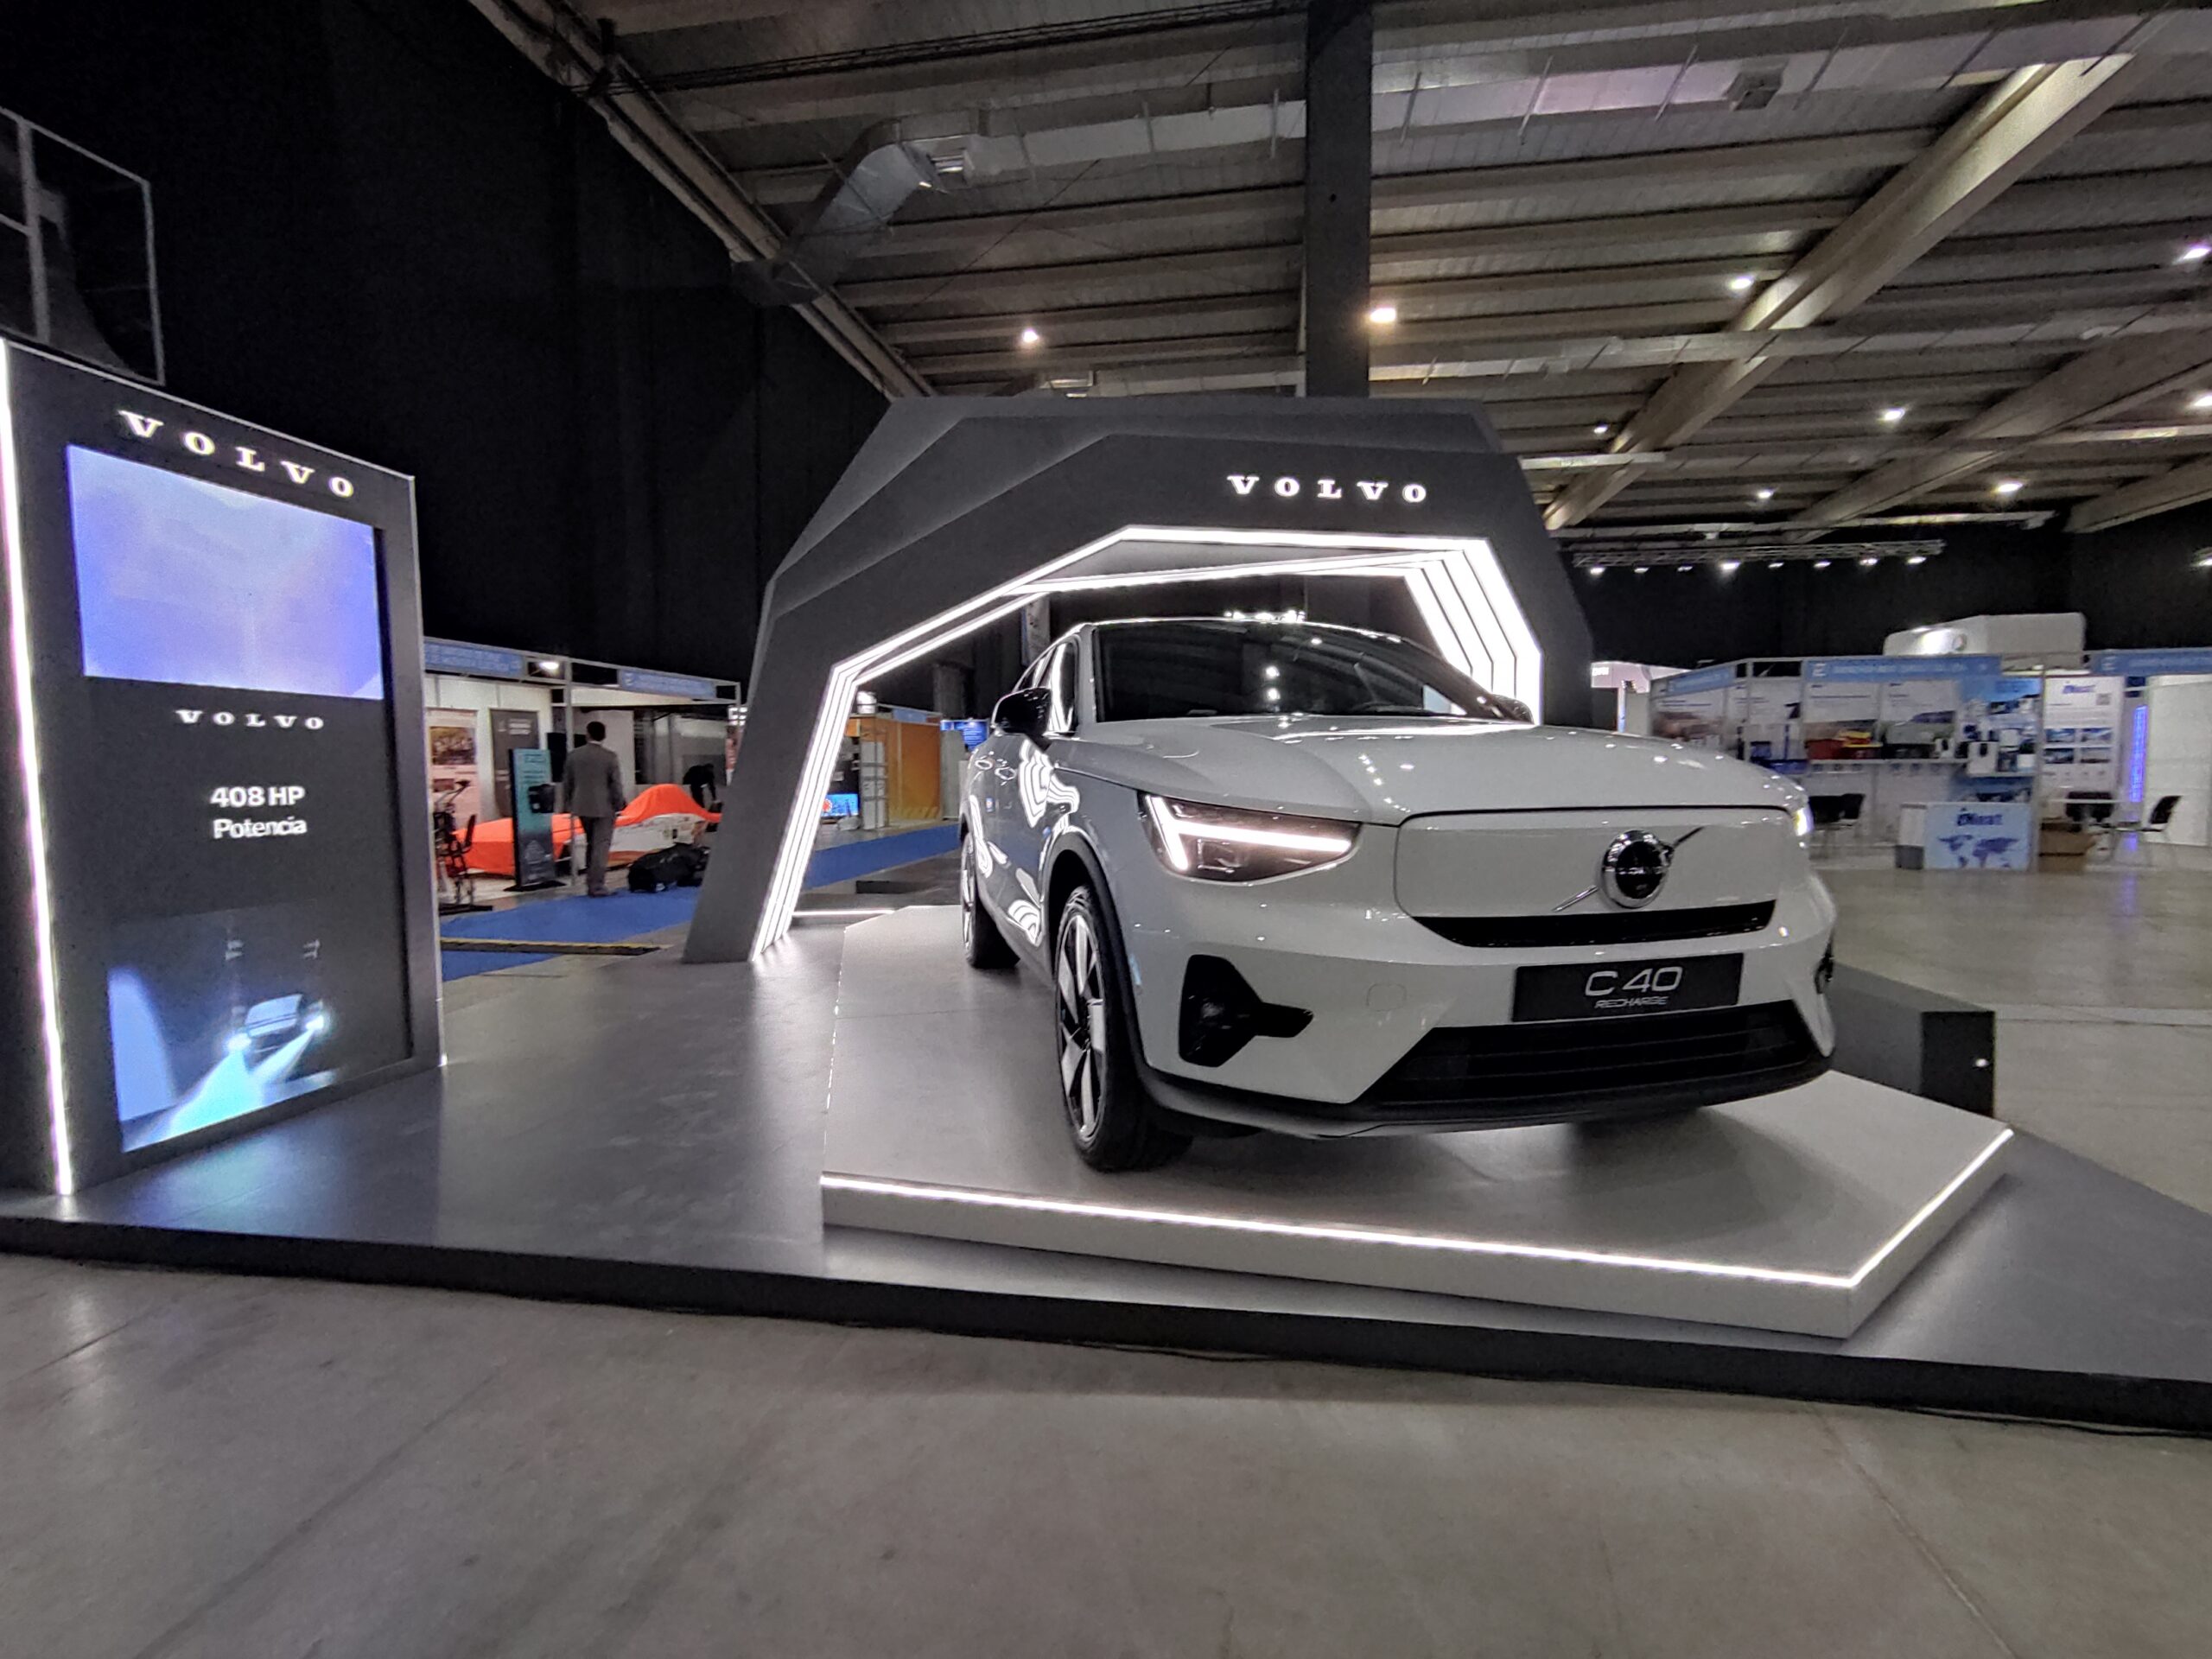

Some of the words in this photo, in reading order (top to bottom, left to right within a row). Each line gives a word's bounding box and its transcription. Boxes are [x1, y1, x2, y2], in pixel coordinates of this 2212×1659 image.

[117, 410, 354, 498] VOLVO
[1226, 474, 1427, 503] VOLVO
[175, 709, 324, 730] VOLVO
[209, 785, 265, 808] 408
[267, 785, 306, 806] HP
[1593, 995, 1669, 1009] RECHARGE
